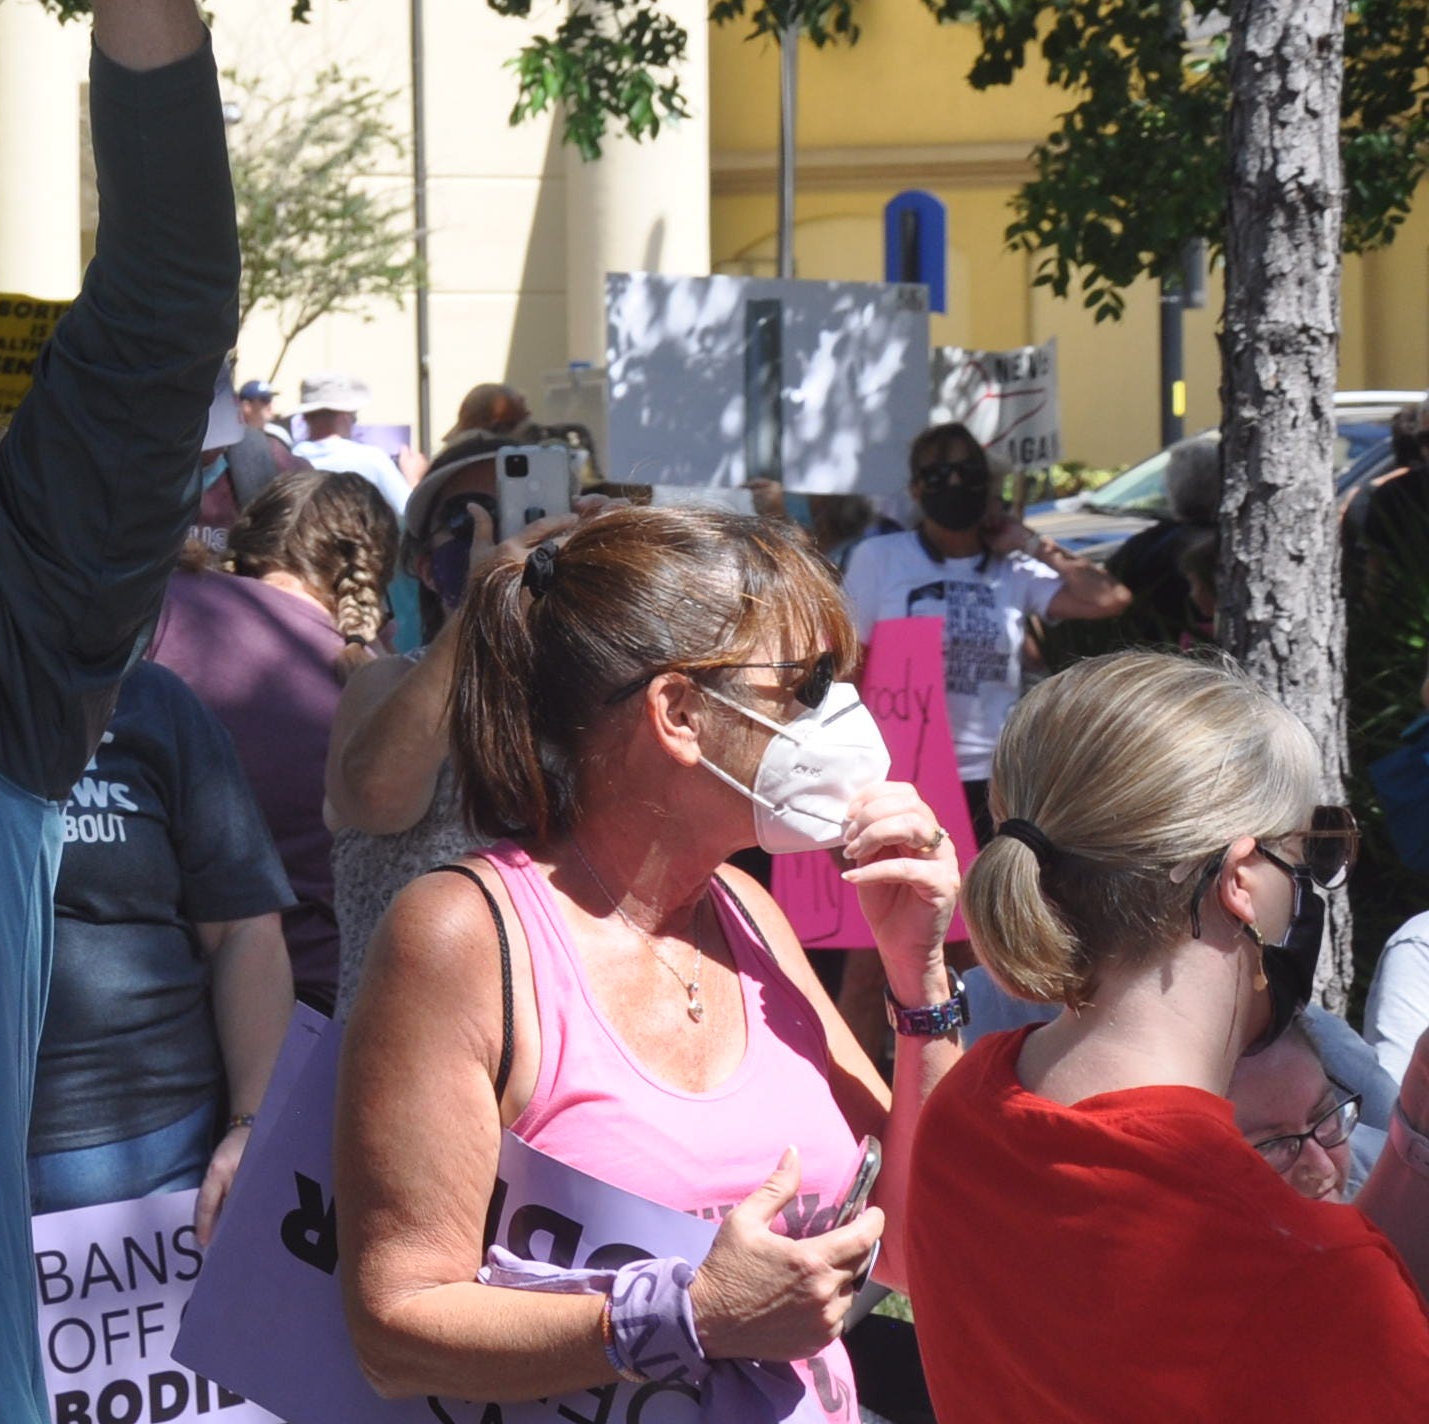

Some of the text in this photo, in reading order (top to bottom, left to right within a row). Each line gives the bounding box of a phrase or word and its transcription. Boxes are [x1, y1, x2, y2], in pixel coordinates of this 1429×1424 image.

[61, 813, 126, 843] BOUT
[35, 1224, 204, 1306] BANS
[48, 1301, 165, 1374] OFF
